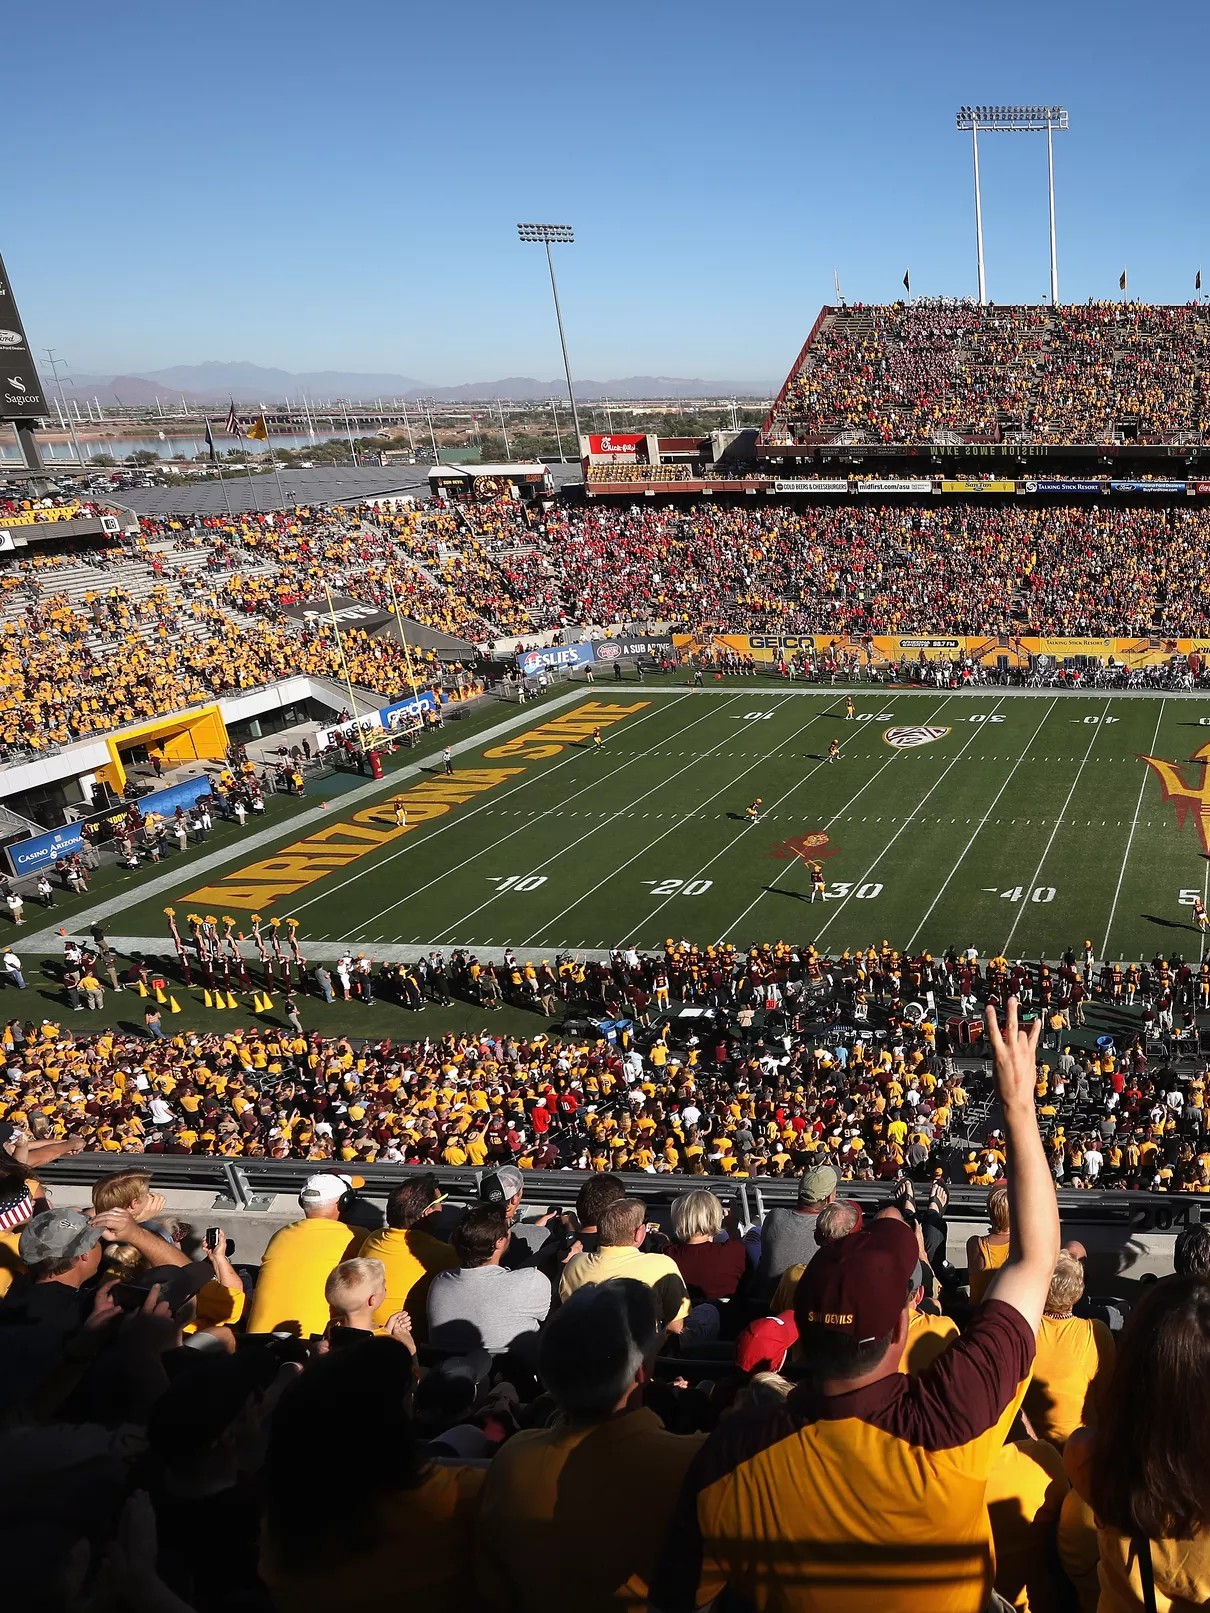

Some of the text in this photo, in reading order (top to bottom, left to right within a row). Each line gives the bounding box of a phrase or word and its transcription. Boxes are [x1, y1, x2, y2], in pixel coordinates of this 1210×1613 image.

[5, 393, 39, 405] Sagicor
[859, 482, 910, 490] midfirst.com/asu
[624, 644, 629, 654] A
[630, 643, 645, 653] SUB
[749, 636, 815, 649] GEICO
[528, 648, 580, 668] LESLIE'S
[176, 701, 652, 911] ARIZONA STATE
[18, 836, 84, 863] CASINO ARIZONA
[501, 875, 548, 893] 10
[649, 879, 714, 897] 20
[826, 882, 884, 900] 30
[1000, 886, 1057, 904] 40
[766, 1000, 775, 1009] 30
[561, 1102, 570, 1110] 10
[1132, 1207, 1192, 1230] 204
[824, 1313, 854, 1325] DEVILS
